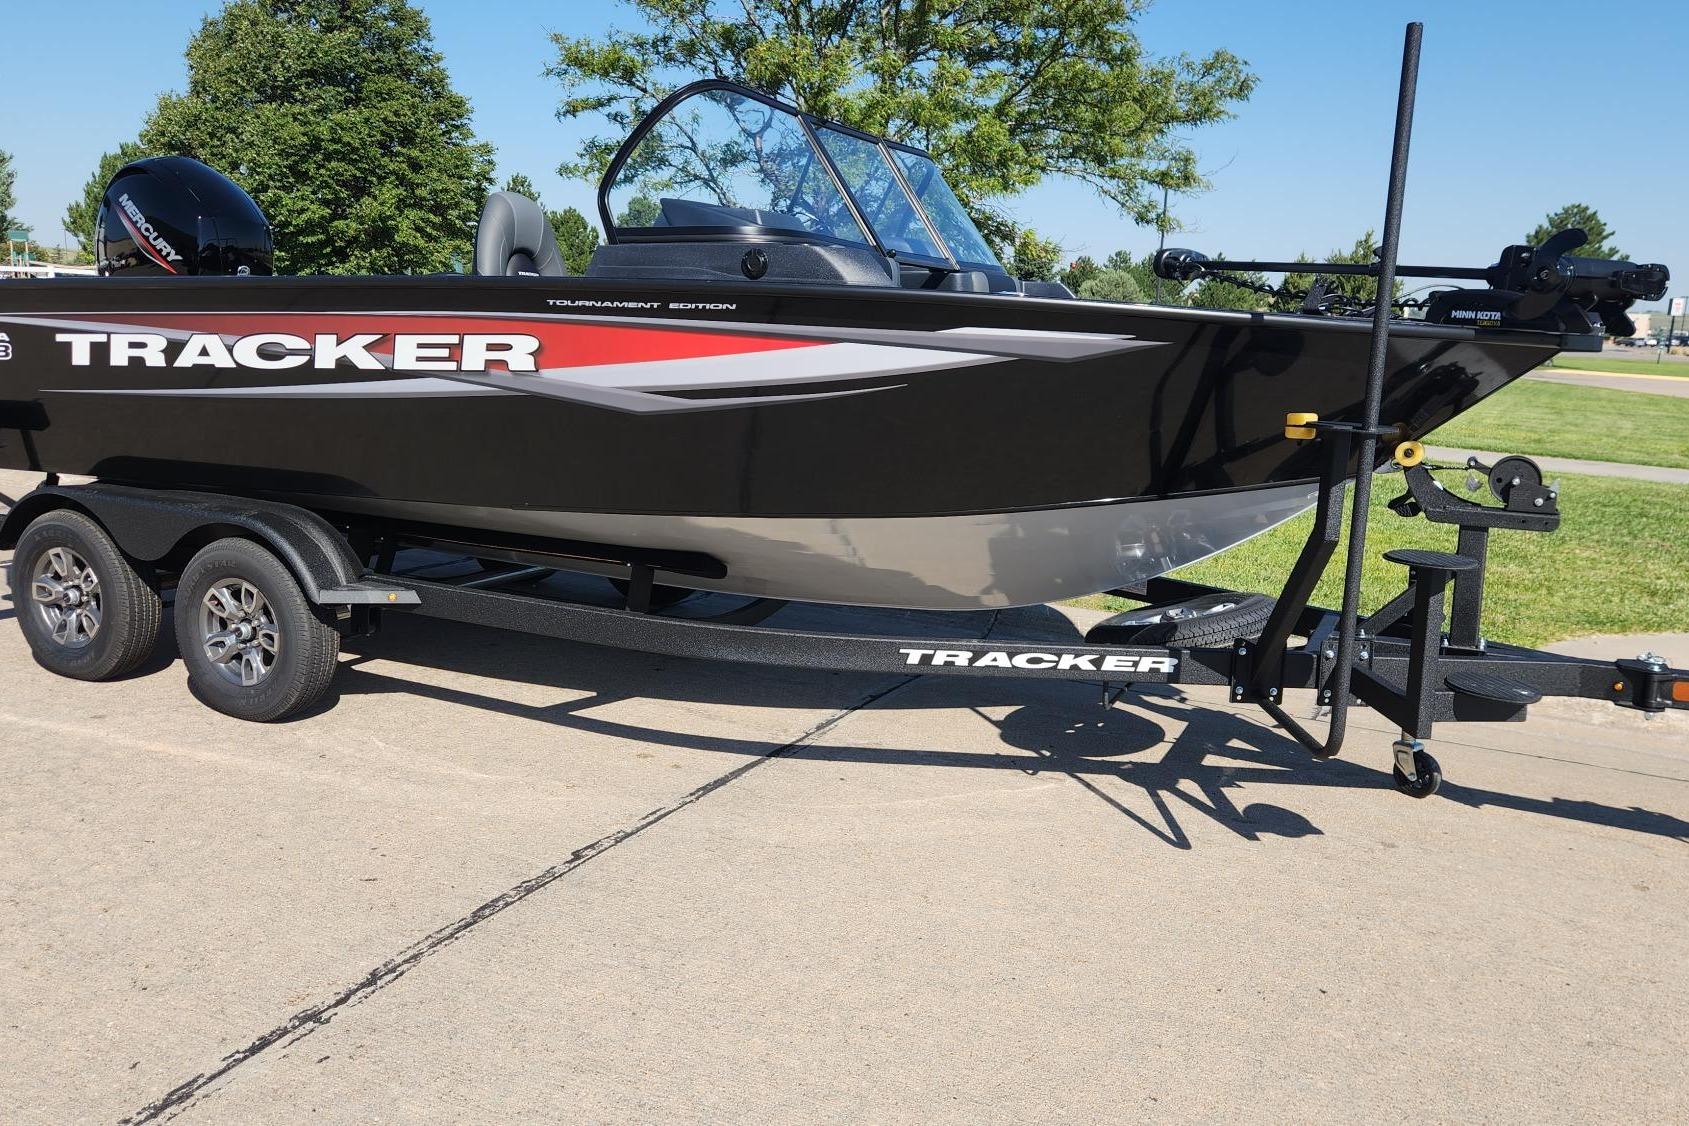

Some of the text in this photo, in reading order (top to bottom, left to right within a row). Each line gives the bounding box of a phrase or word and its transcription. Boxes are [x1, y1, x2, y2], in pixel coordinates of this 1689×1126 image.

[118, 193, 183, 262] MERCURY
[546, 299, 737, 310] TOURNAMENT EDITION
[1451, 310, 1501, 320] MINN KOTA
[54, 332, 540, 373] TRACKER
[899, 648, 1179, 673] TRACKER
